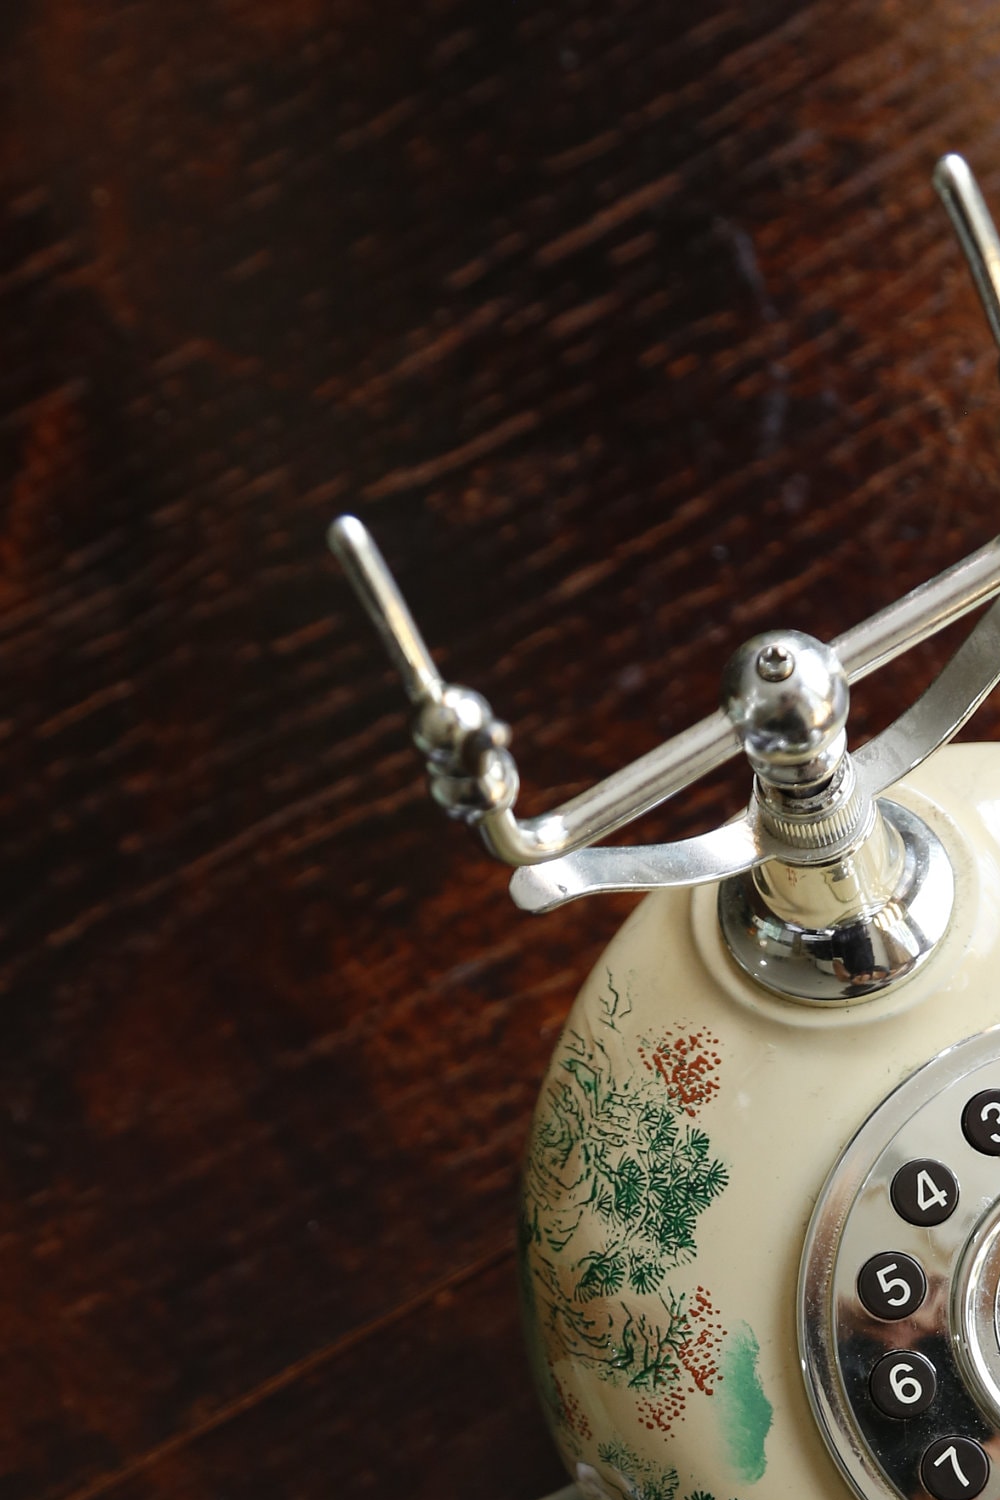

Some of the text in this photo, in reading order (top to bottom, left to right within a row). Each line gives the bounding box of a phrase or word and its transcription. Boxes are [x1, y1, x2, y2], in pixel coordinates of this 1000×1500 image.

[917, 1169, 948, 1211] 4
[876, 1263, 911, 1307] 5
[889, 1363, 923, 1404] 6
[933, 1445, 970, 1487] 7
